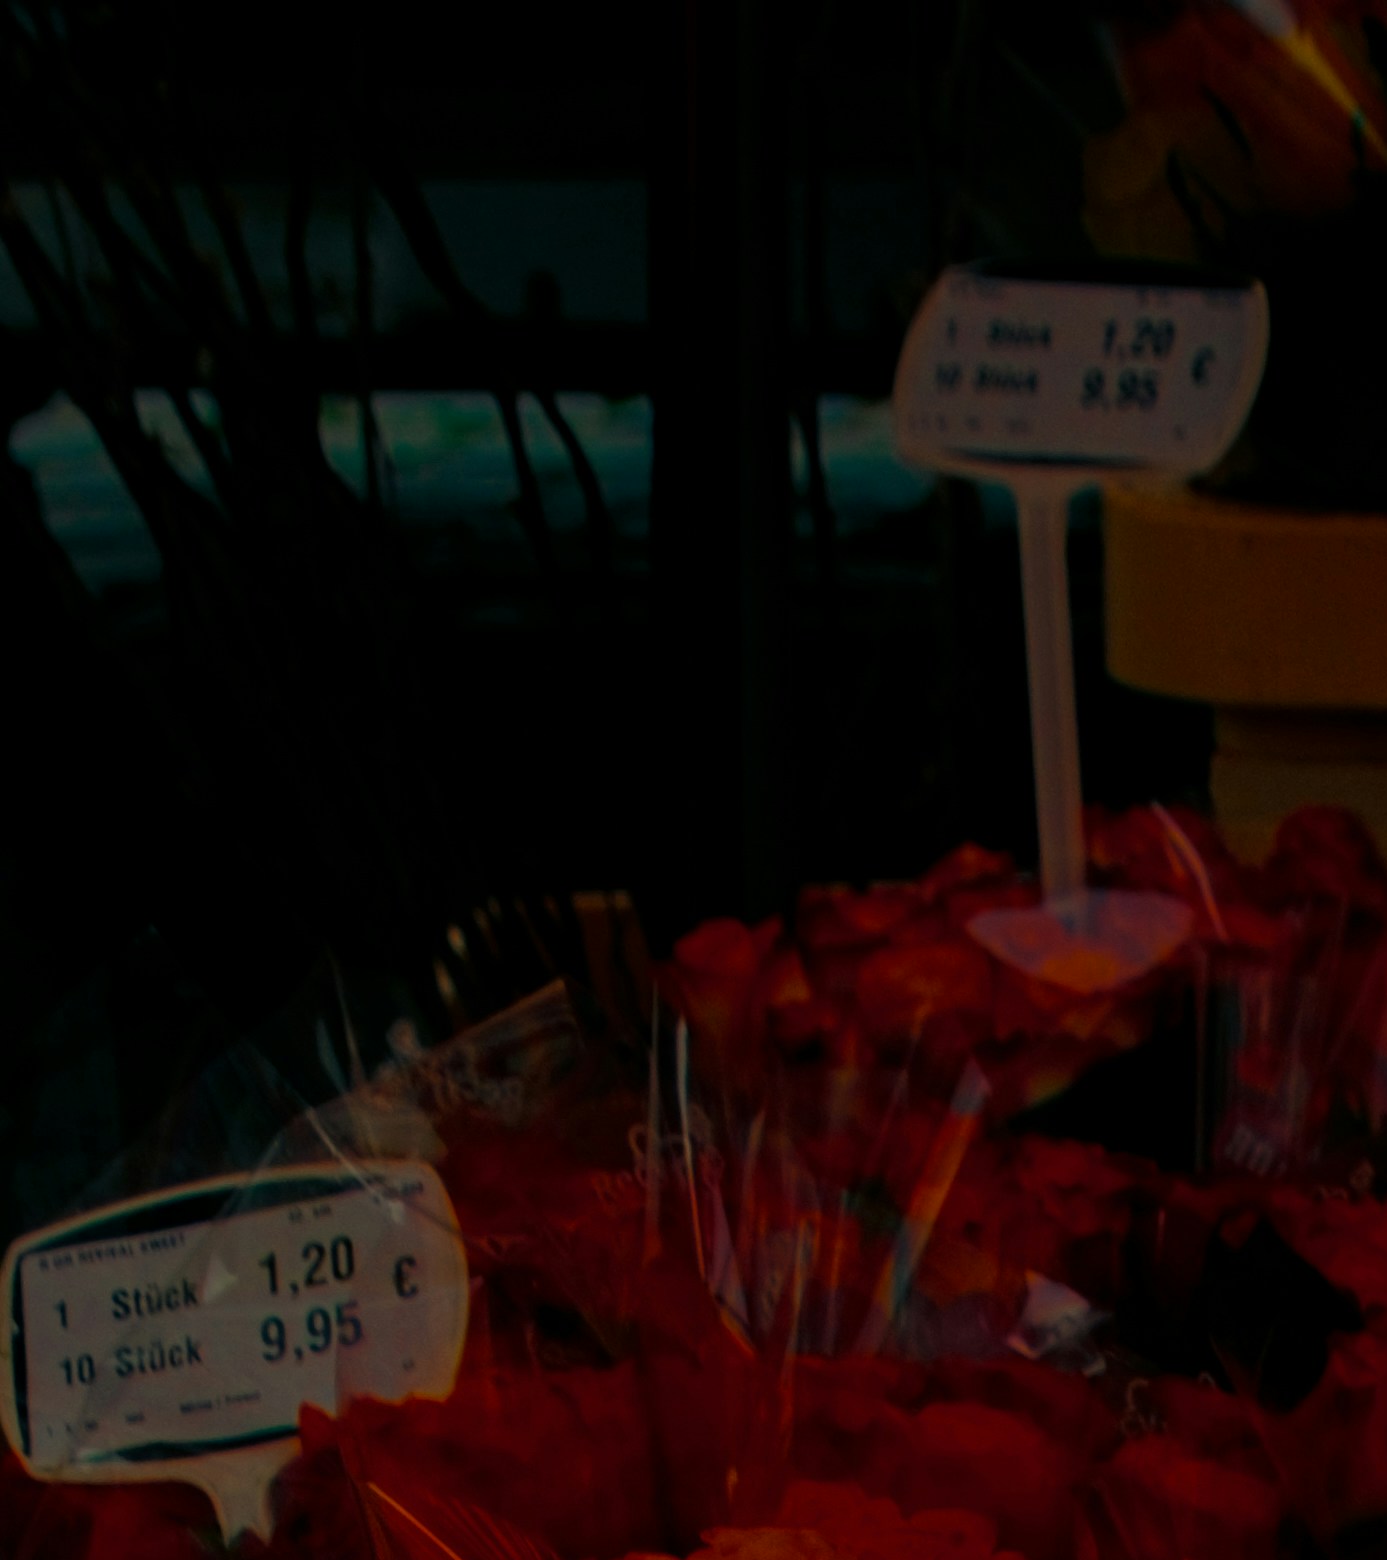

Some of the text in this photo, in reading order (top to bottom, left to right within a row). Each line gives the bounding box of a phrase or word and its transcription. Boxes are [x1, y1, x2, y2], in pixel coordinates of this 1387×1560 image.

[1103, 315, 1176, 358] 1,20
[1081, 364, 1159, 410] 9,95
[55, 1236, 355, 1329] 1 Stück 1,20
[393, 1256, 419, 1299] €
[62, 1299, 363, 1387] 10 Stück 9,95
